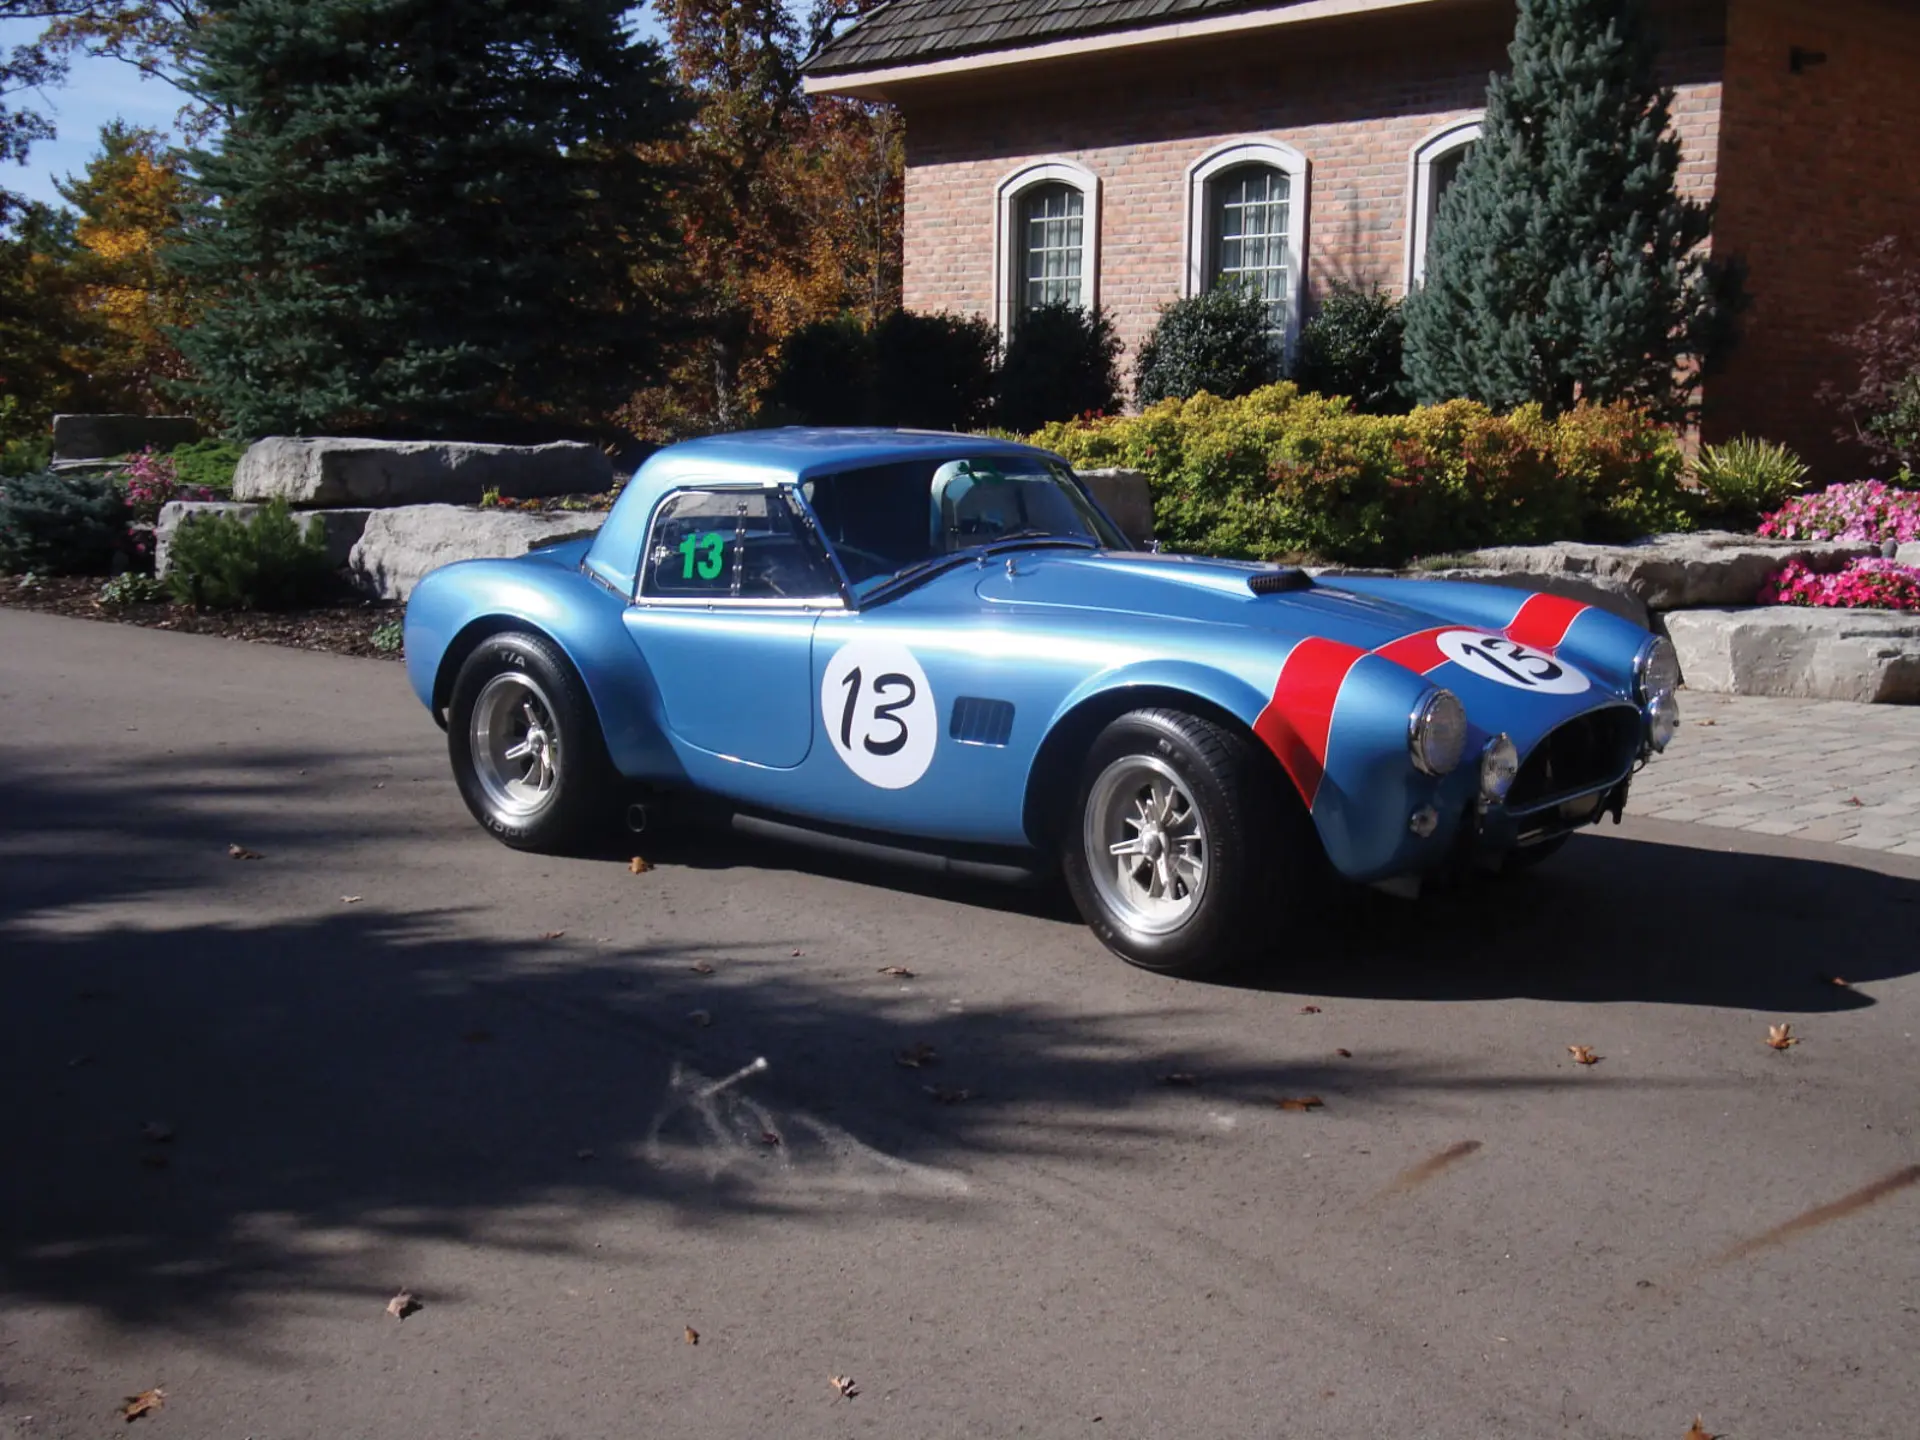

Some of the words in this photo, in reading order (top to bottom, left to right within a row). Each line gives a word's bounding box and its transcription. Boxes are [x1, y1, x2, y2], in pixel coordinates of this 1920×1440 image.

[679, 532, 724, 580] 13
[1461, 638, 1563, 686] 13
[841, 666, 916, 756] 13
